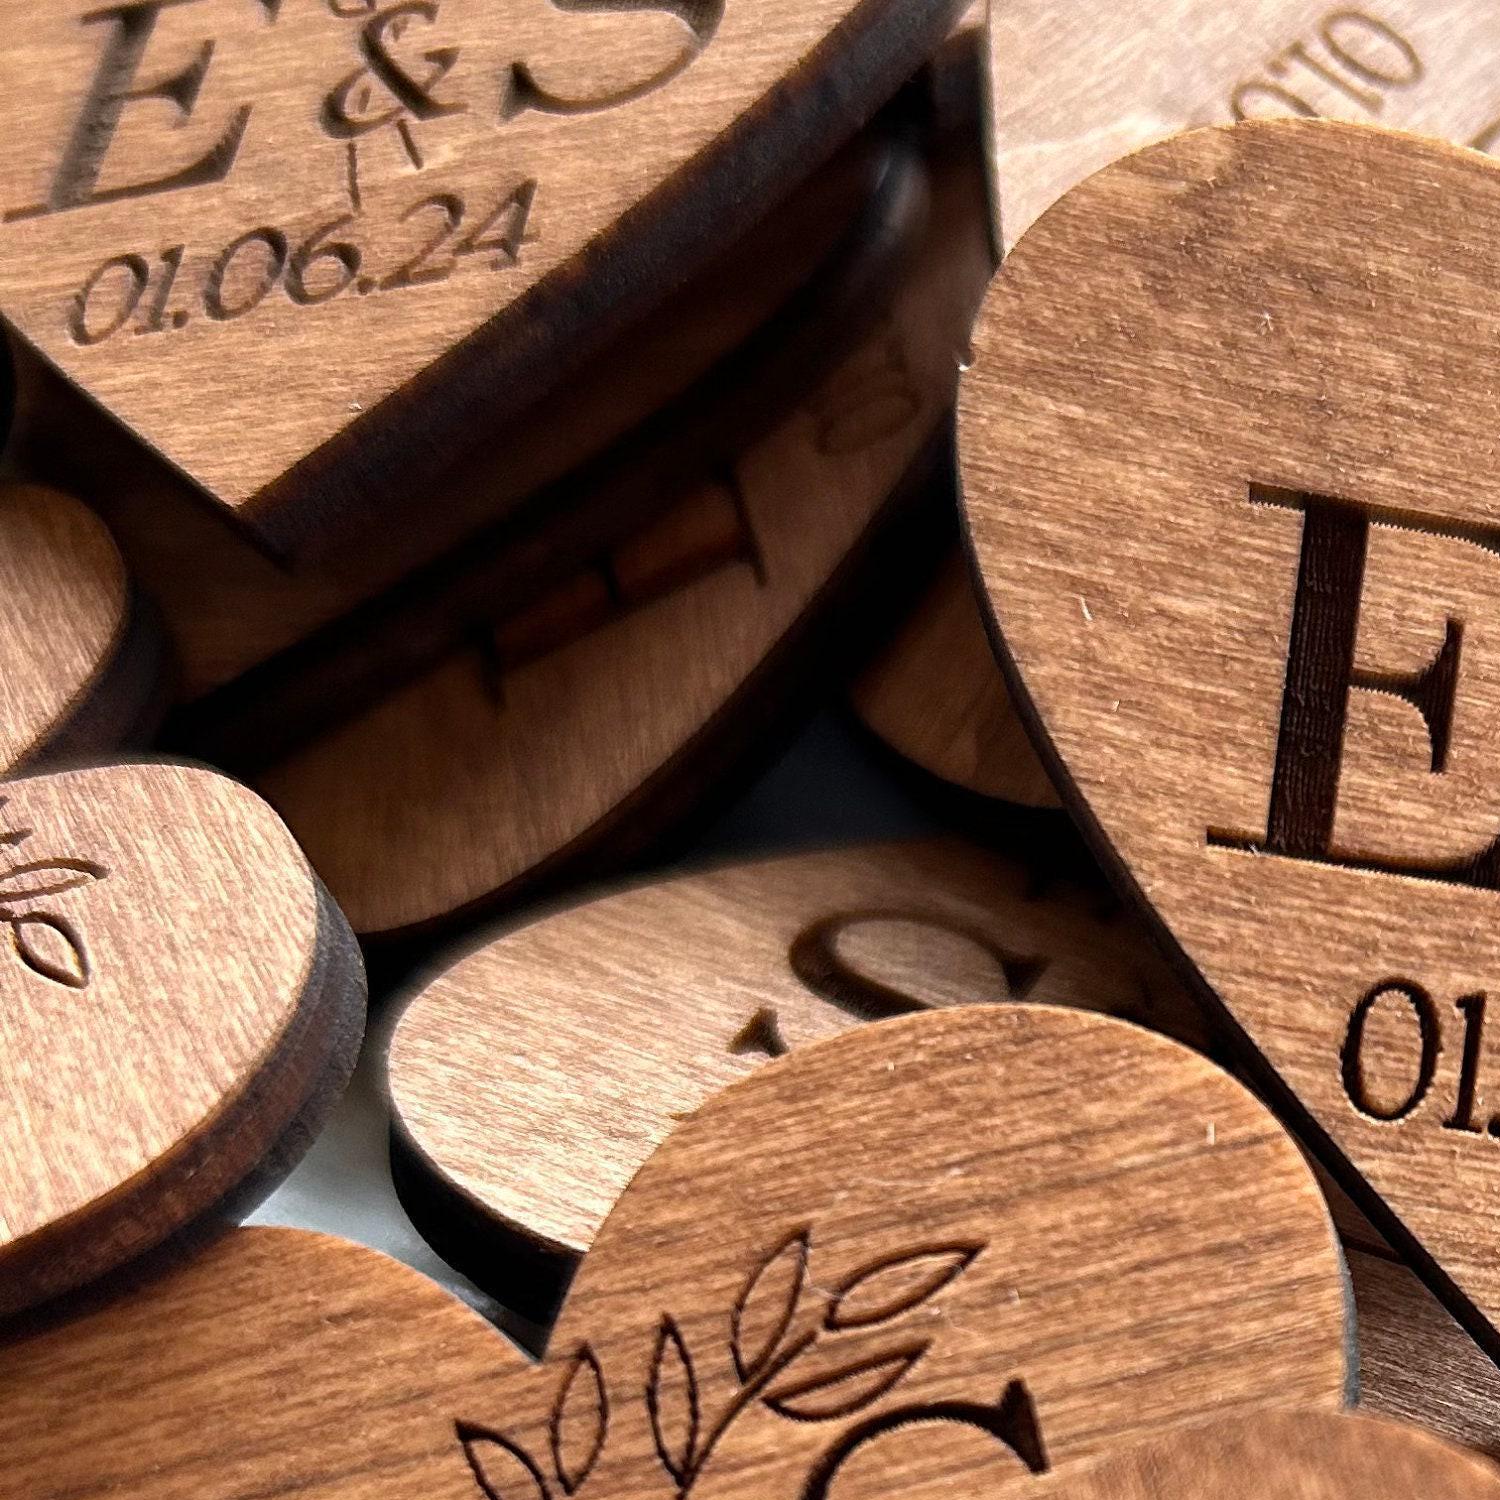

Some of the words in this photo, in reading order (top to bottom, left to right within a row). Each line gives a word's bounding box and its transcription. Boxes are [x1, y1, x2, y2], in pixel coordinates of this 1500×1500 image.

[2, 0, 280, 223] E
[318, 0, 470, 140] &
[66, 177, 540, 346] 01.06.24
